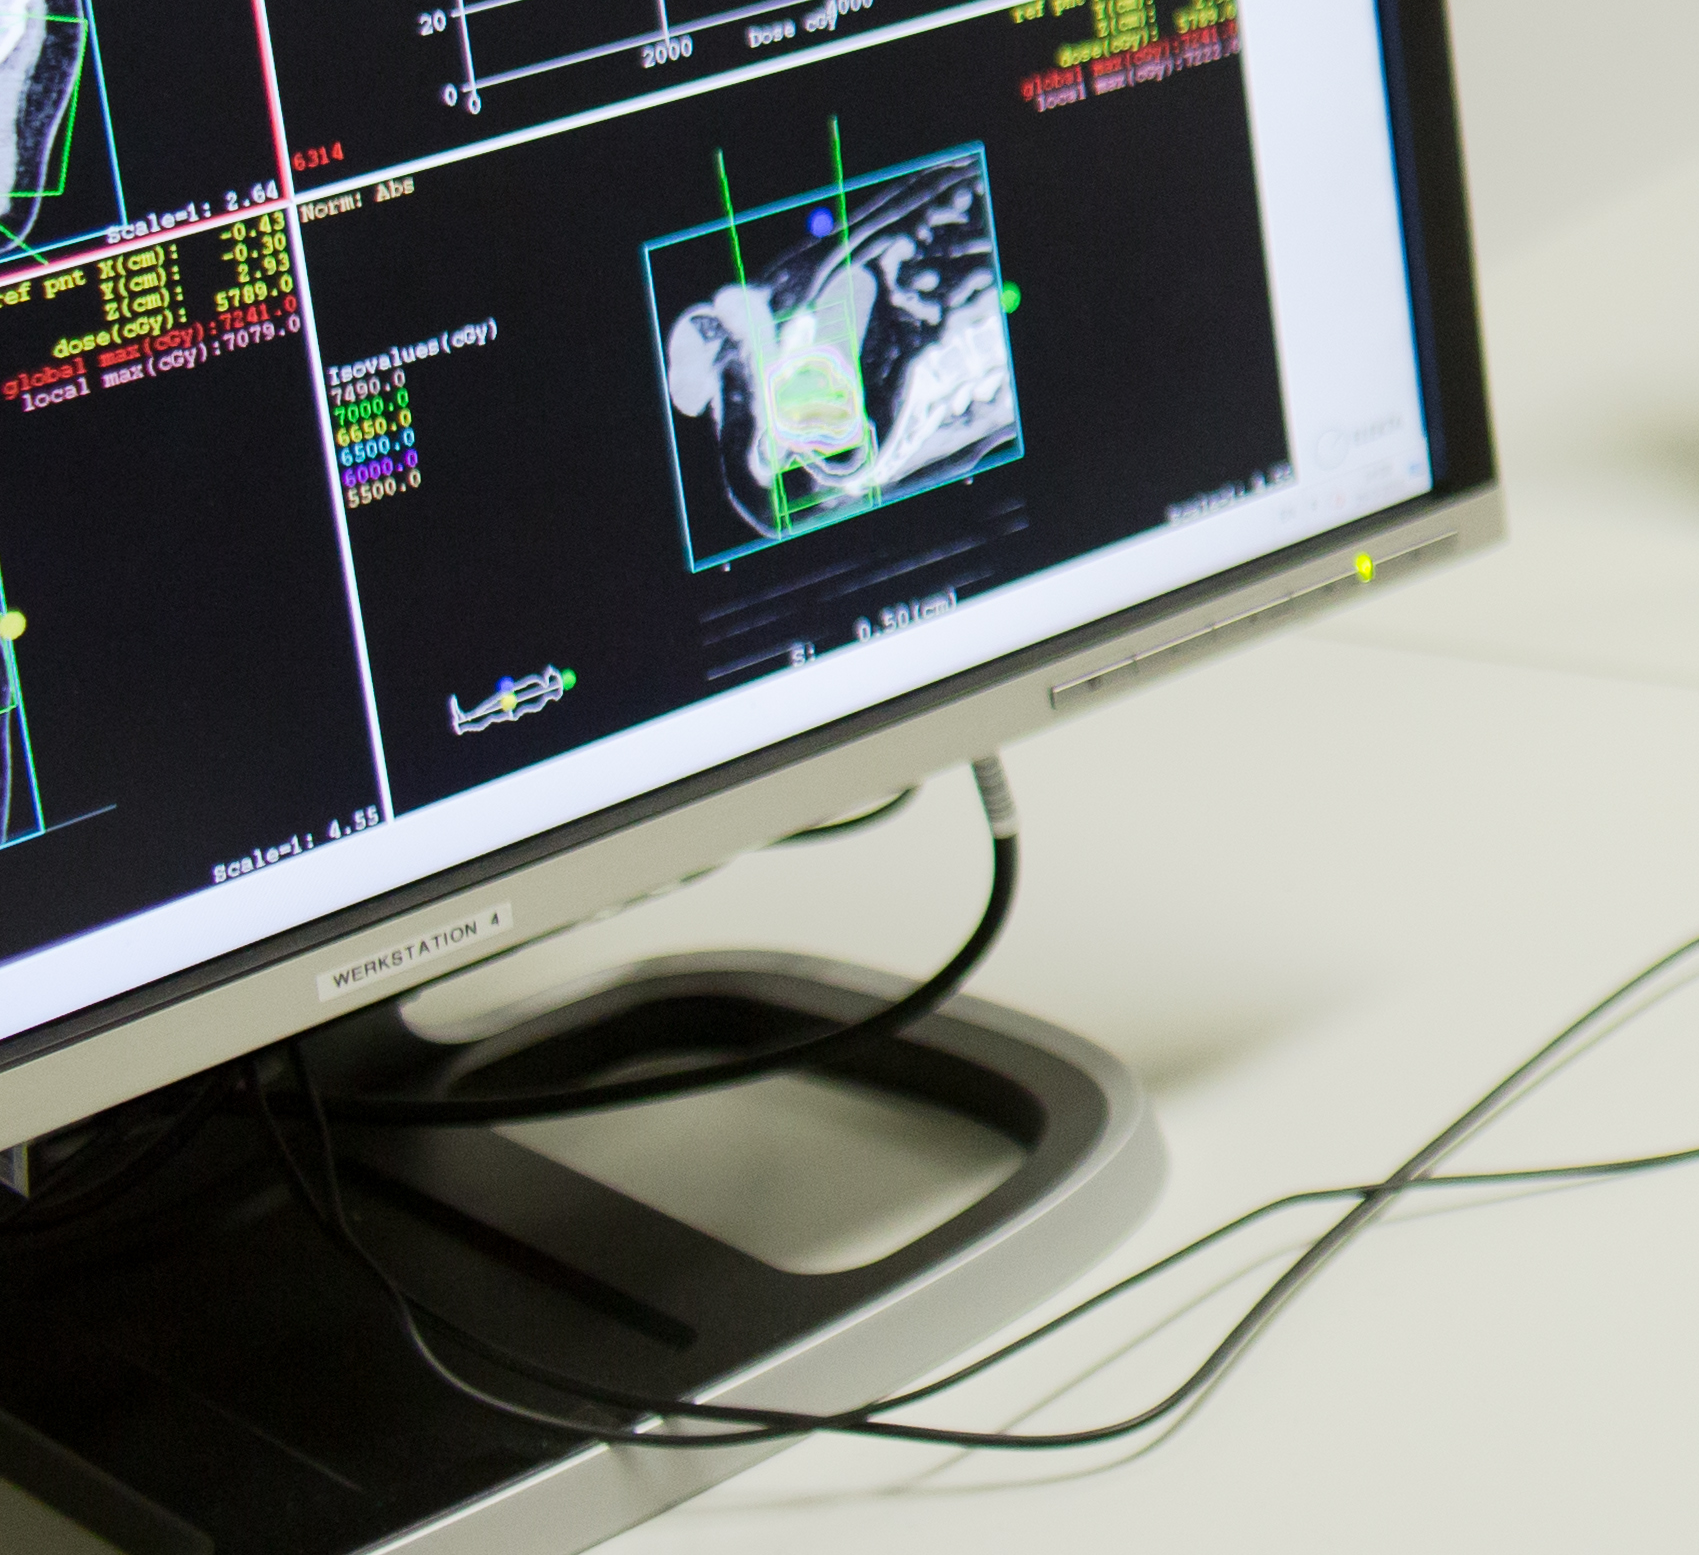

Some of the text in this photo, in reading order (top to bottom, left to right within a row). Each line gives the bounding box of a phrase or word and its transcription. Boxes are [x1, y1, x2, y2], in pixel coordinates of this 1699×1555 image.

[417, 8, 447, 37] 20
[747, 18, 797, 49] Dose
[641, 33, 694, 69] 2000
[292, 141, 345, 172] 6314
[106, 179, 280, 244] Scale=1: 2.64
[299, 176, 415, 224] Norm: Abs
[43, 268, 88, 299] pnt
[97, 243, 179, 280] X(cm):
[219, 210, 286, 240] -0.43
[99, 231, 288, 300] Y(cm): -0.30
[104, 251, 291, 322] Z(cm): 2.93
[52, 273, 294, 359] dose(cGy): 5789.0
[327, 316, 498, 386] Isovalues(cGy)
[1, 357, 88, 401] global
[22, 376, 92, 413] local
[330, 367, 406, 406] 7490.0
[333, 387, 410, 426] 7000.0
[337, 407, 412, 447] 6650.0
[339, 426, 416, 467] 6500.0
[342, 447, 419, 488] 6000.0
[346, 467, 422, 509] 5500.0
[212, 804, 380, 885] Scale=1: 4.55
[333, 911, 500, 988] WERKSTATION 4
